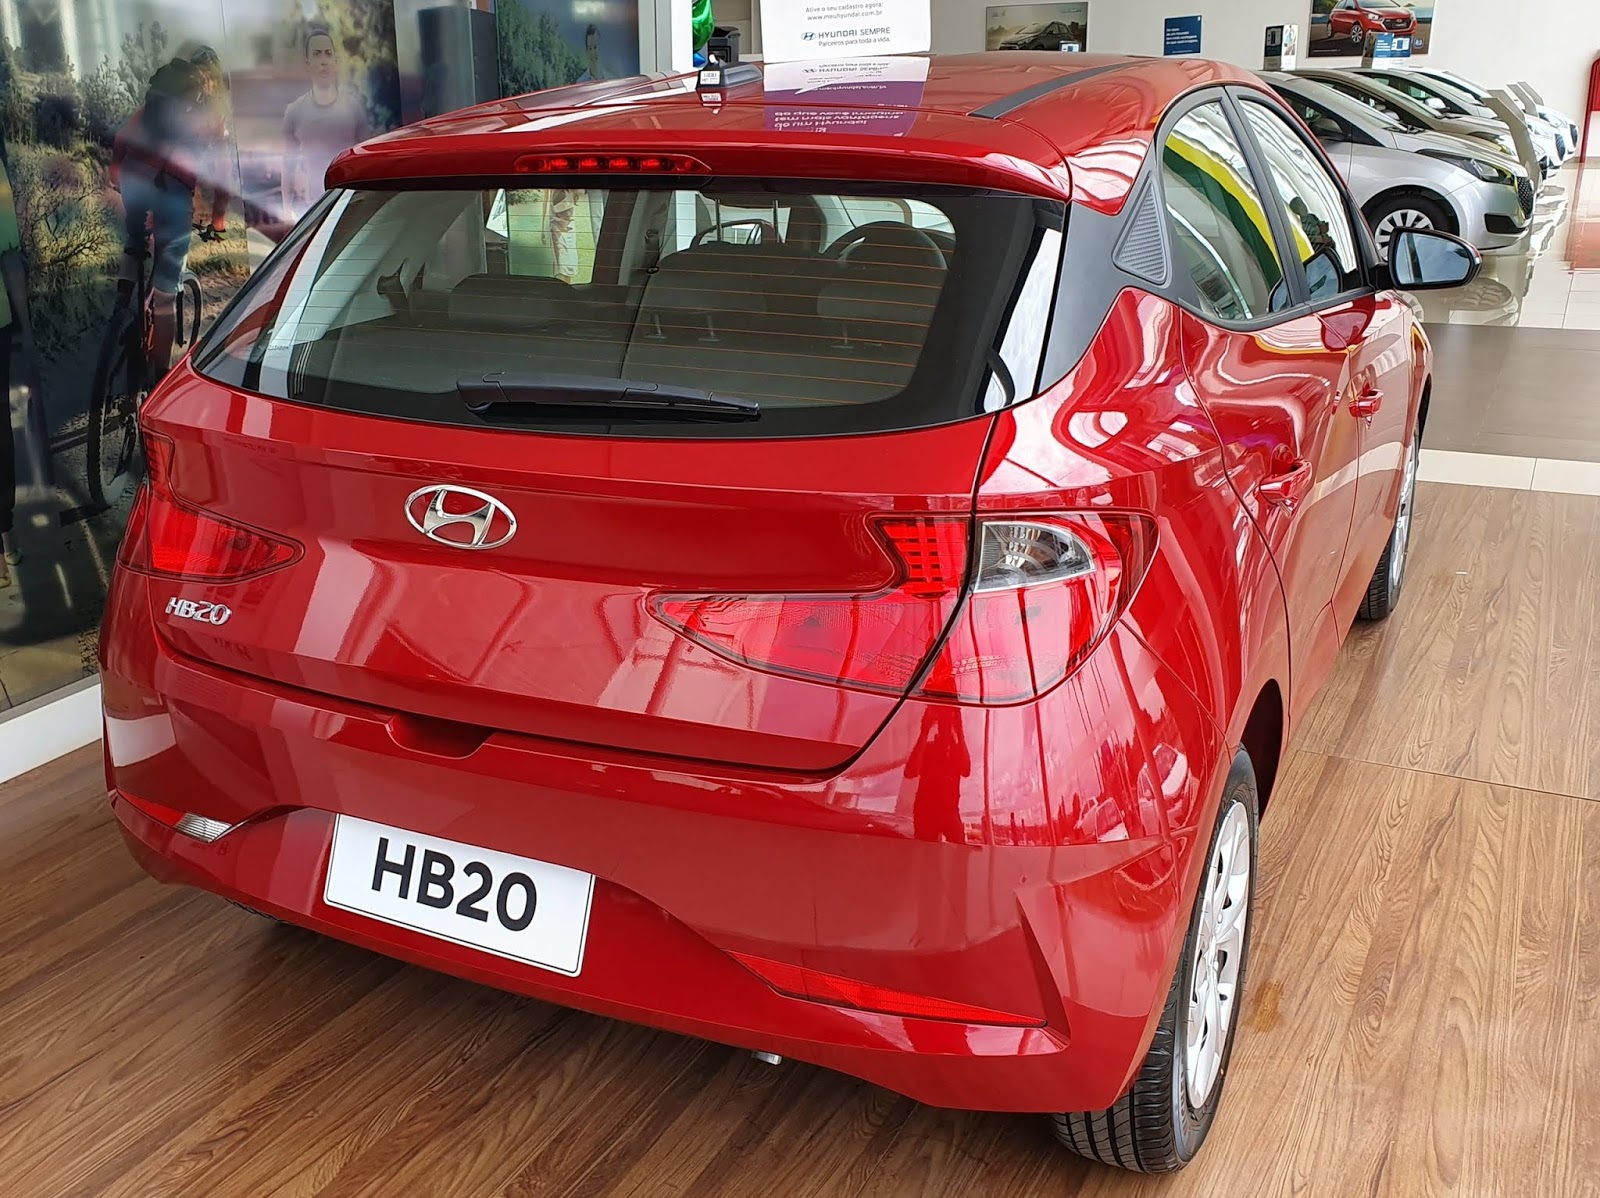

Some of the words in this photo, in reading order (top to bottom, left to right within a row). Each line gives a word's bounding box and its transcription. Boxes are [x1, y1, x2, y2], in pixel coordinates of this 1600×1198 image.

[807, 10, 883, 20] www.meuhyundai.com.br
[818, 29, 858, 39] HYUNDAI
[860, 27, 891, 35] SEMPRE
[165, 596, 232, 625] HB20
[371, 836, 537, 932] HB20
